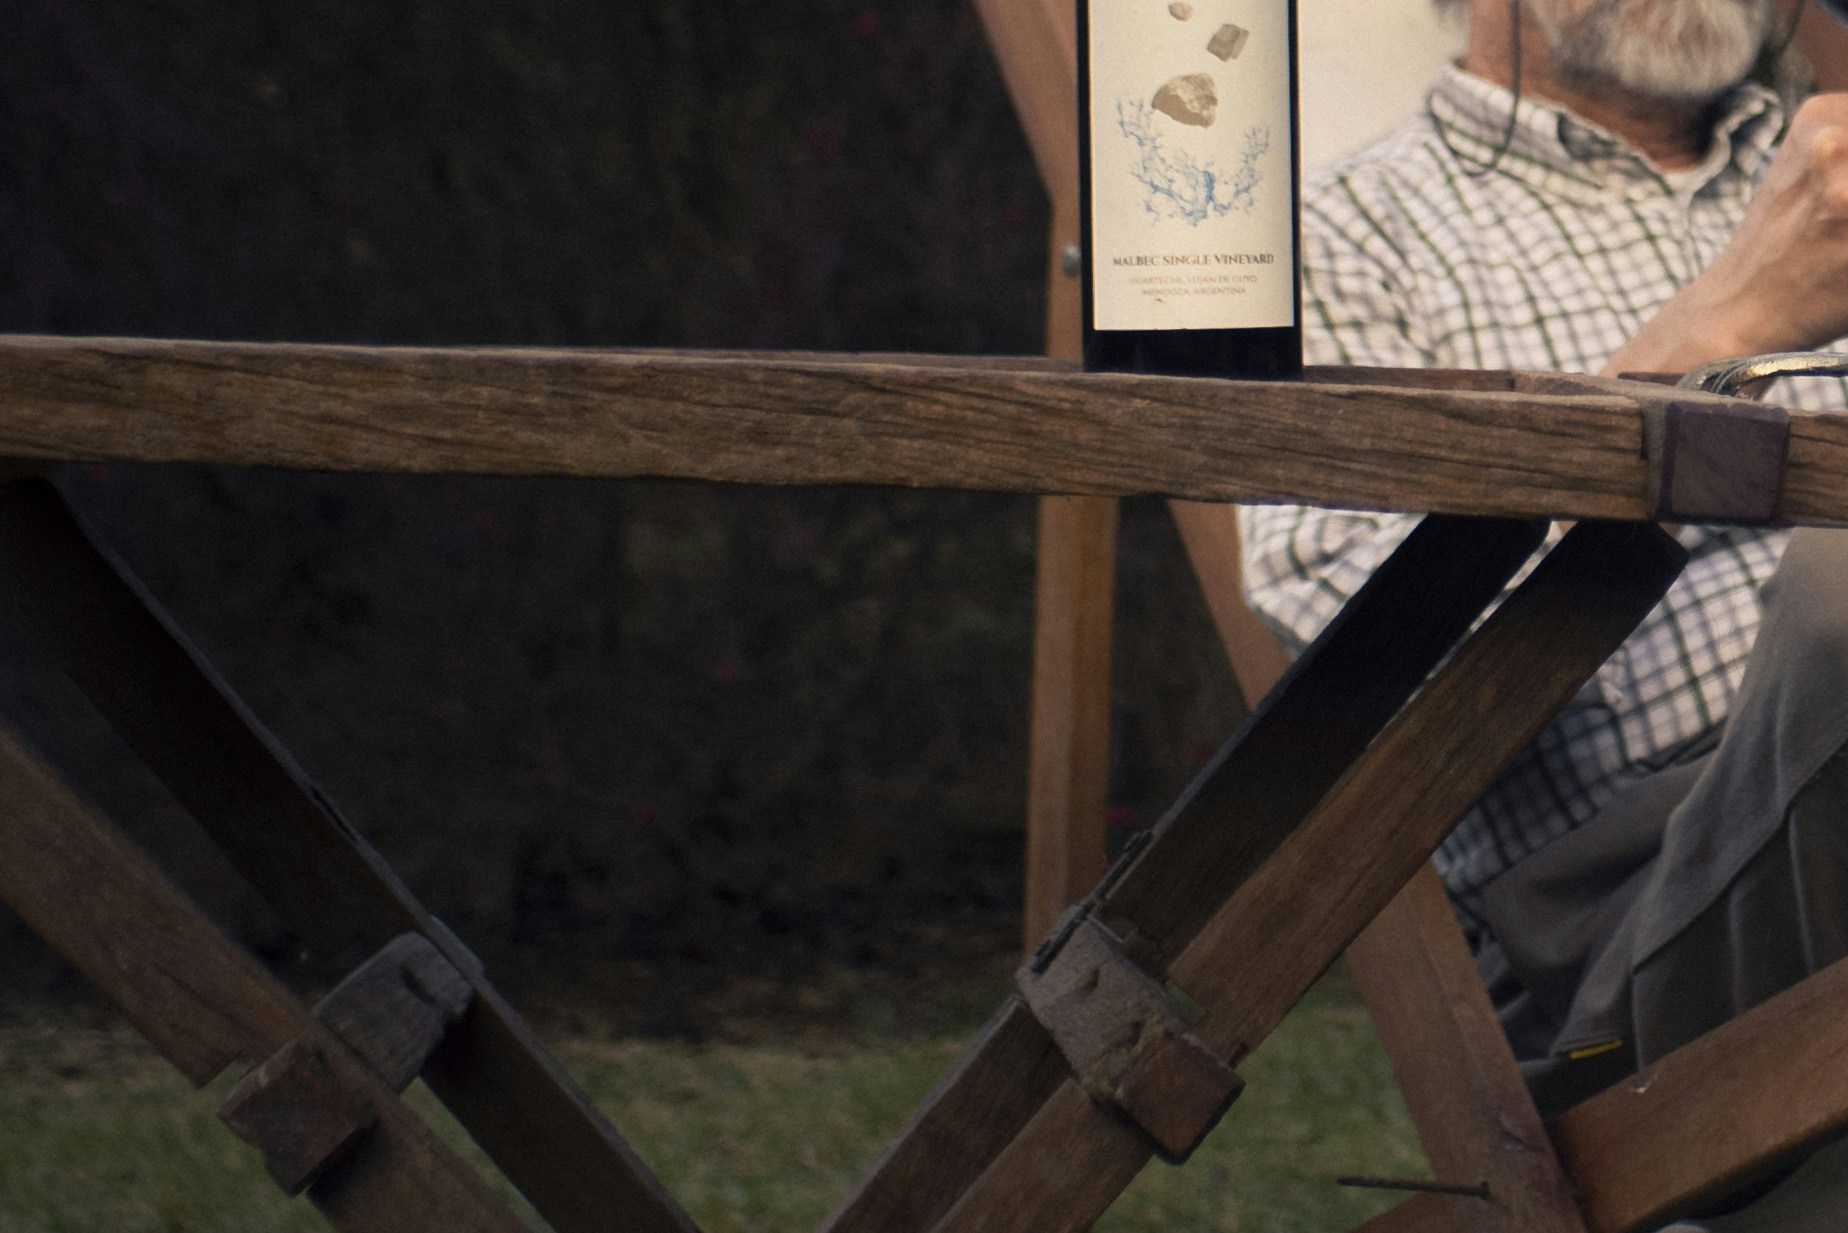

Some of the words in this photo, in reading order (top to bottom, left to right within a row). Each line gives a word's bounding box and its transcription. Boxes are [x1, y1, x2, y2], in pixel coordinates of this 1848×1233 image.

[1113, 255, 1160, 267] MALBEC
[1163, 254, 1210, 265] SINGLE
[1214, 253, 1274, 264] VINEYARD
